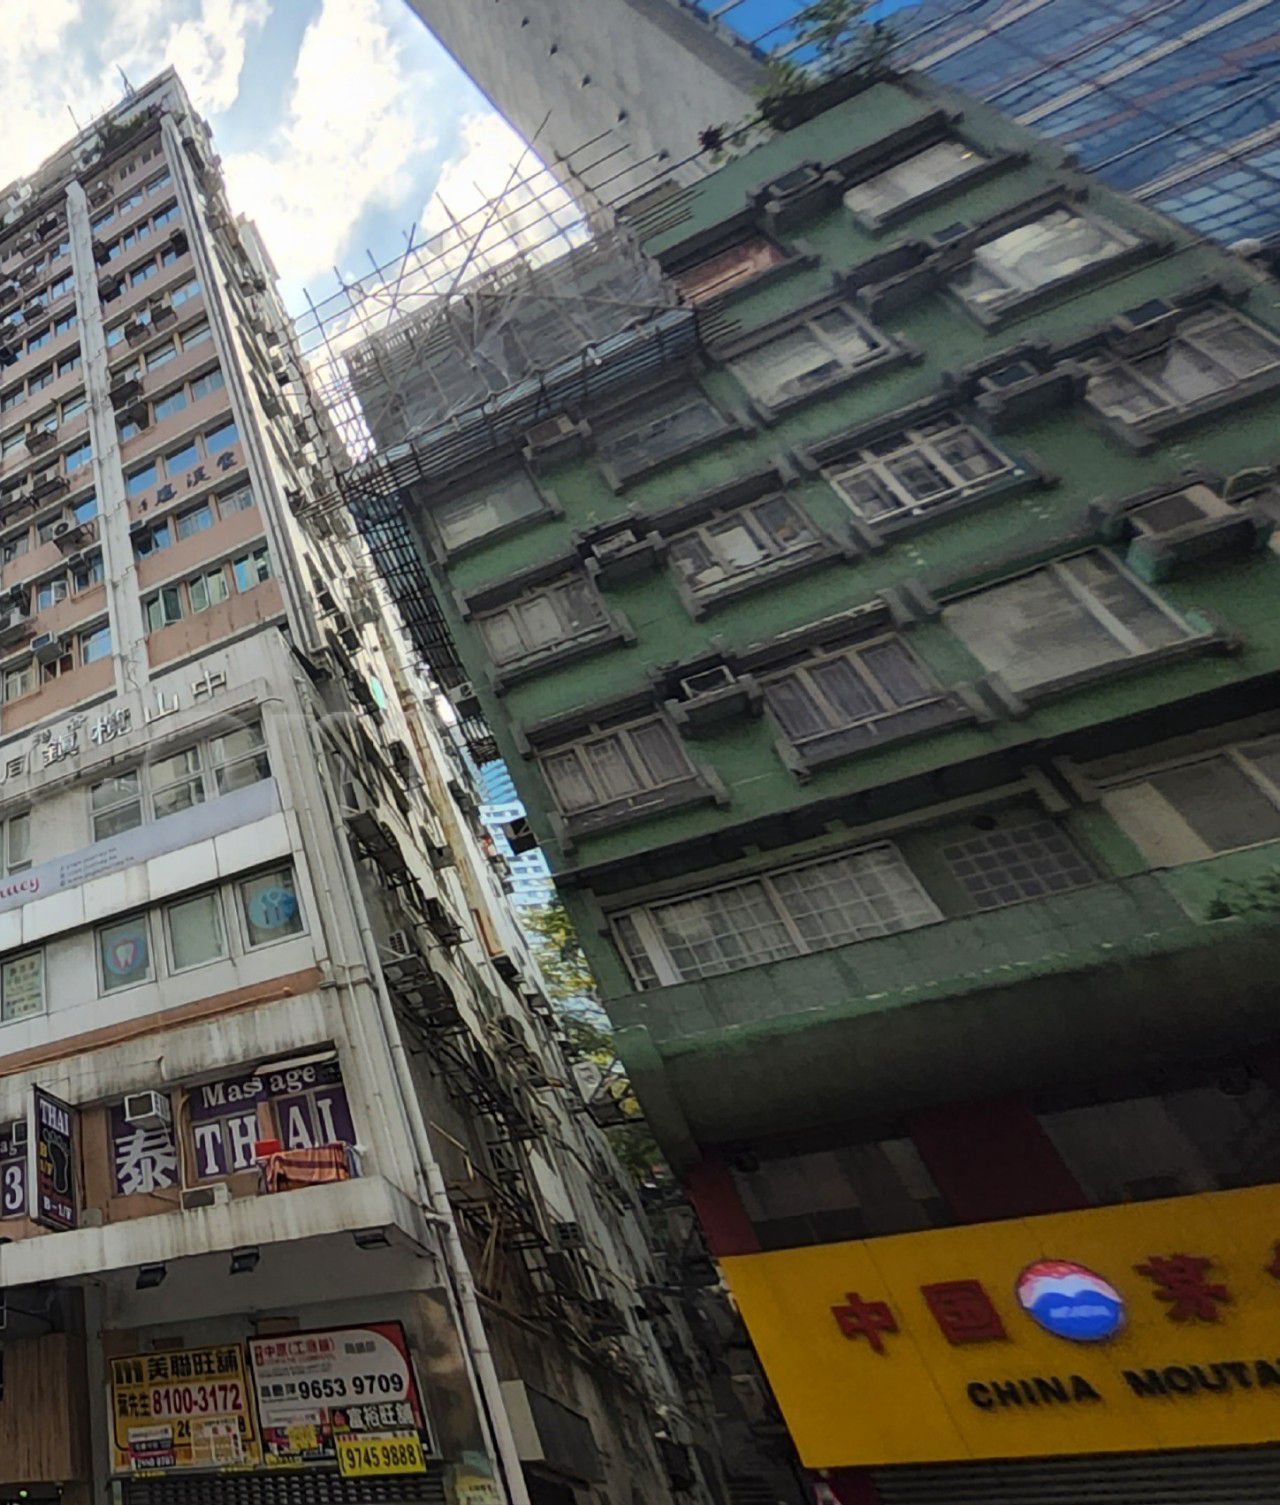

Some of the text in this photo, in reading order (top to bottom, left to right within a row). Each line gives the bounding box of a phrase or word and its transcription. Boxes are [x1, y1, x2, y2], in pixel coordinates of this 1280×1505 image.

[39, 1098, 70, 1137] THAI
[195, 1098, 339, 1176] THAI
[115, 1127, 177, 1197] 泰
[153, 1383, 243, 1415] 8100-3172
[298, 1378, 347, 1400] 9653
[352, 1373, 404, 1396] 9709
[967, 1359, 1280, 1410] CHINA MOUTA
[346, 1443, 417, 1469] 9745 9888
